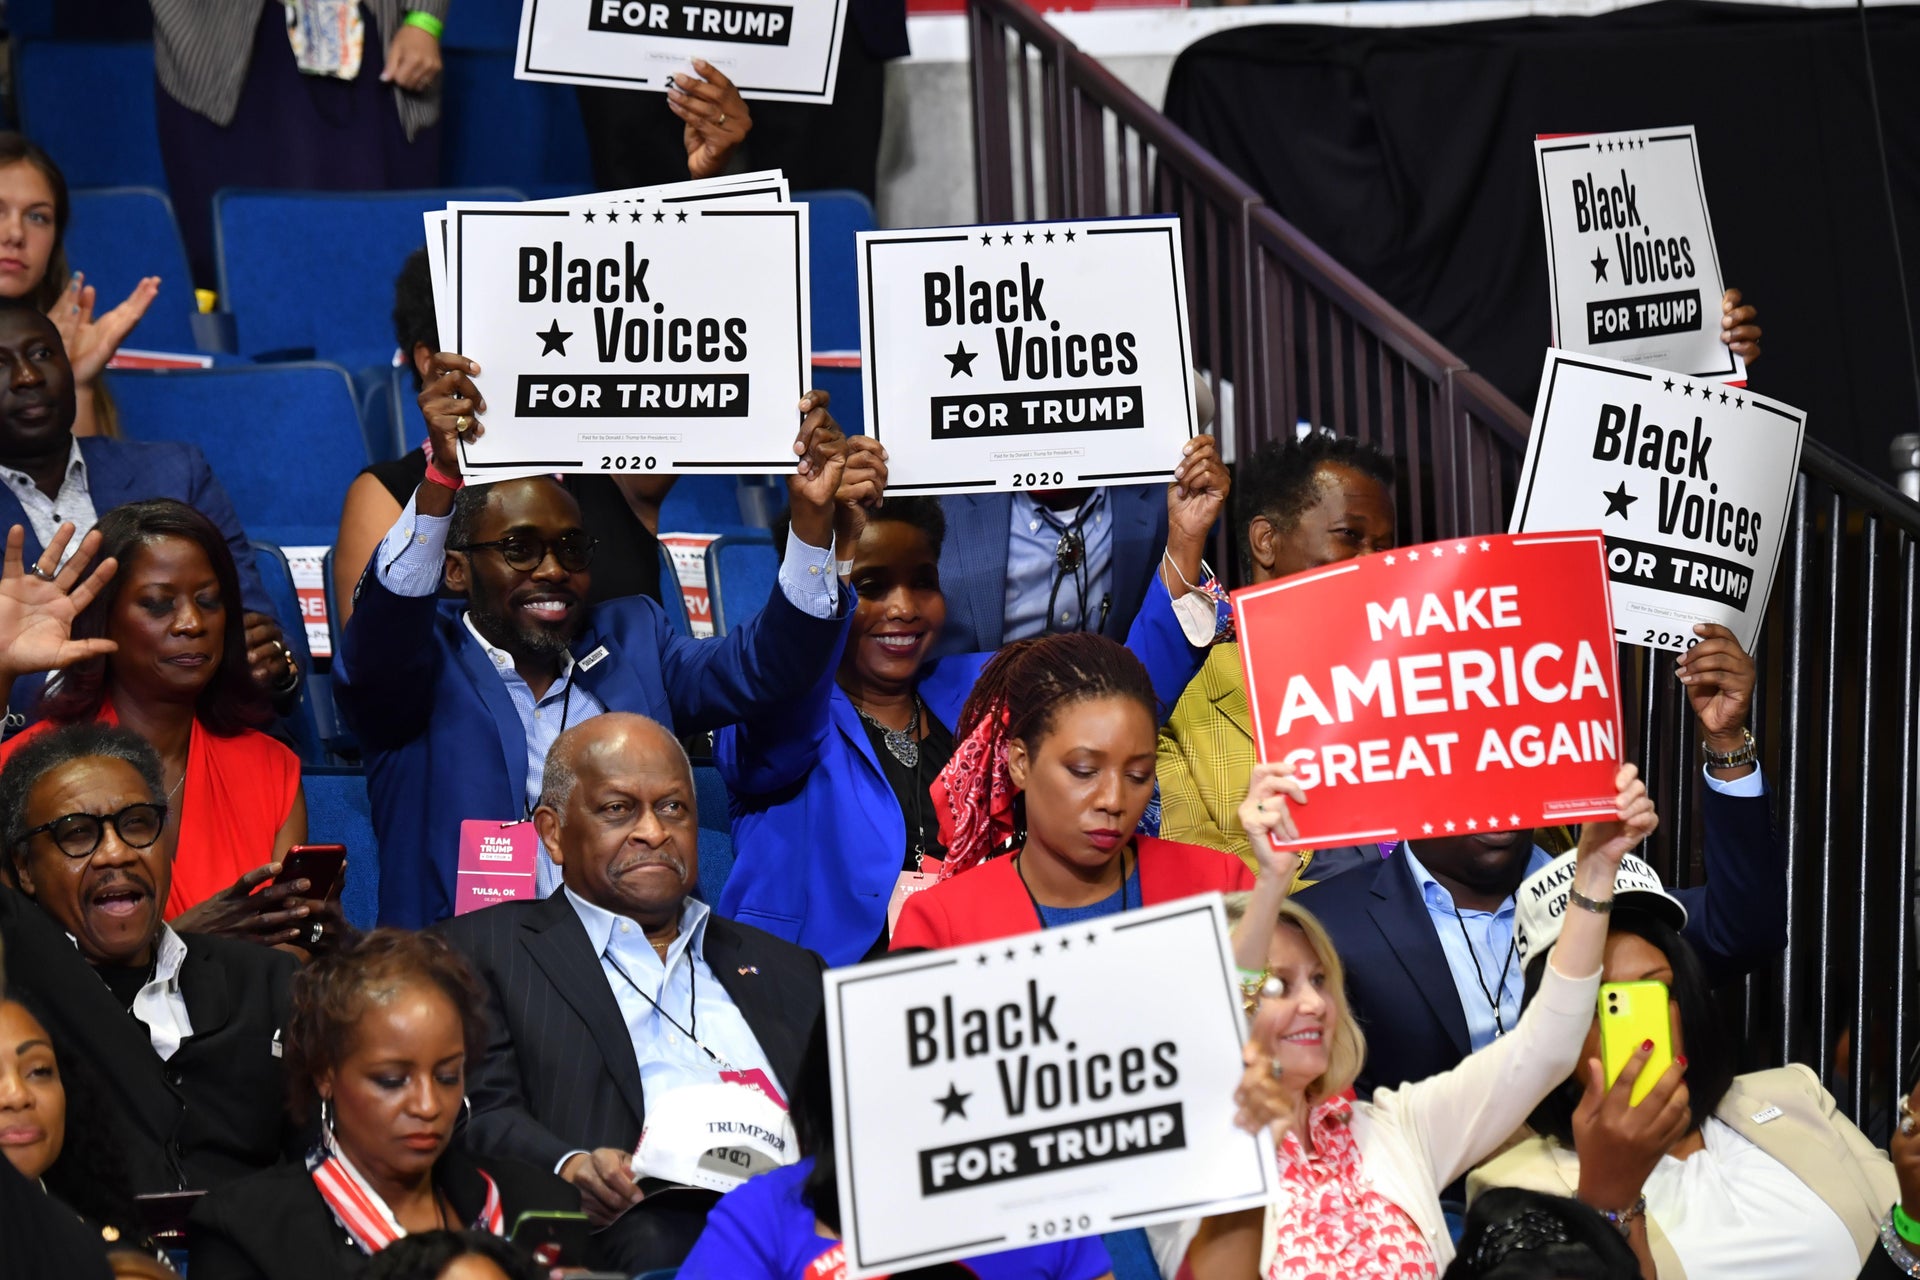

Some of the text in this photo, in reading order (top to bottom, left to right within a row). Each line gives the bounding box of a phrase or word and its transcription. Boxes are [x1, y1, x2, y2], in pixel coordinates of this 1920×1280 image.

[601, 0, 784, 36] FOR TRUMP
[1572, 169, 1641, 233] Black
[519, 241, 649, 303] Black
[1616, 226, 1695, 285] Voices
[924, 262, 1046, 326] Black
[1594, 299, 1696, 334] FOR TRUMP
[594, 303, 747, 362] Voices
[996, 320, 1137, 381] Voices
[529, 384, 738, 408] FOR TRUMP
[943, 396, 1133, 429] FOR TRUMP
[601, 456, 656, 469] 2020
[1593, 404, 1712, 480] Black
[1013, 472, 1063, 486] 2020
[1658, 477, 1762, 556] Voices
[1605, 545, 1748, 600] OR TRUMP
[1366, 586, 1521, 641] MAKE
[1276, 640, 1609, 736] AMERICA
[1283, 720, 1615, 791] GREAT AGAIN
[480, 845, 513, 853] TRUMP
[484, 837, 511, 845] TEAM
[472, 887, 516, 896] TULSA, OK
[1530, 859, 1657, 901] MAKE RICA
[906, 978, 1058, 1067] Black
[997, 1040, 1178, 1117] Voices
[932, 1112, 1174, 1186] FOR TRUMP
[1029, 1215, 1090, 1239] 2020
